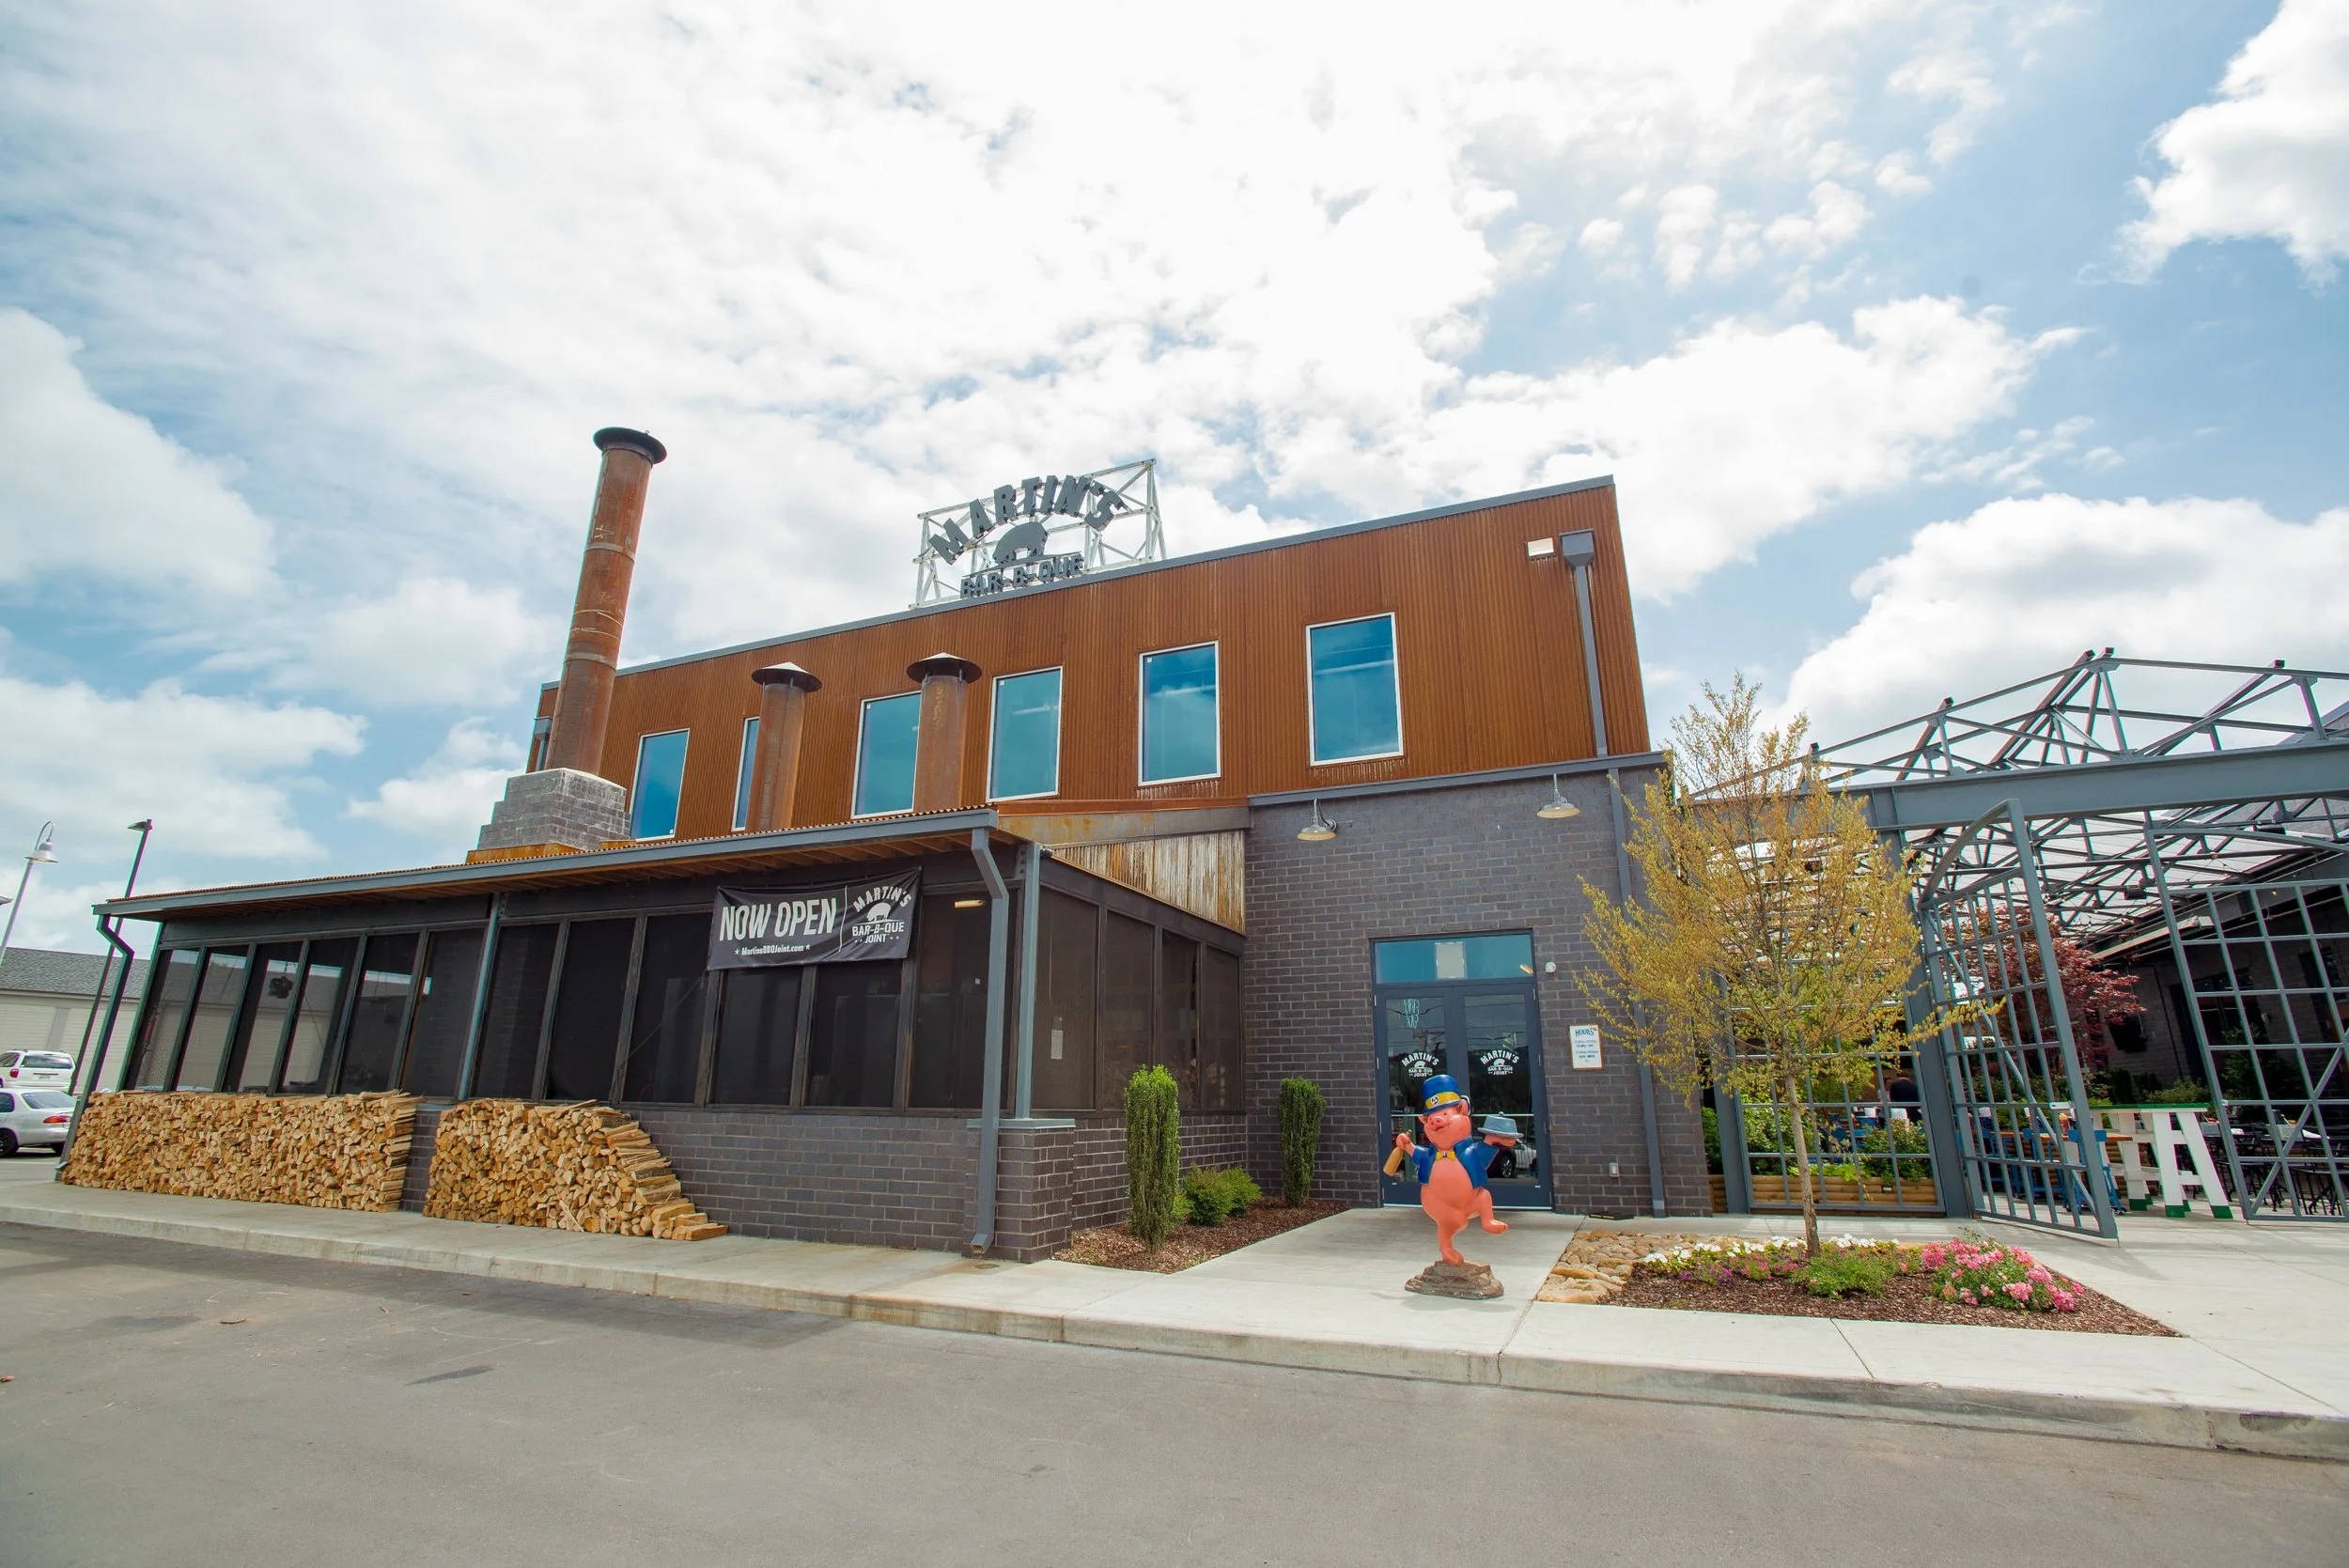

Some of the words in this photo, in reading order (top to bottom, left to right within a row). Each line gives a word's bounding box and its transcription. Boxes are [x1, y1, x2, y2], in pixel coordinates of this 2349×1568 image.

[928, 474, 1125, 566] MARTIN'S
[853, 886, 911, 912] MARTIN'S
[719, 903, 771, 941] NOW
[773, 897, 837, 938] OPEN
[851, 922, 905, 937] BAR-B-QUE
[864, 933, 887, 944] JOINT
[740, 944, 804, 956] MartinsBBQJoint.com
[1575, 1029, 1595, 1037] HOURS
[1401, 1051, 1439, 1067] MARTIN'S
[1480, 1049, 1519, 1065] MARTIN'S
